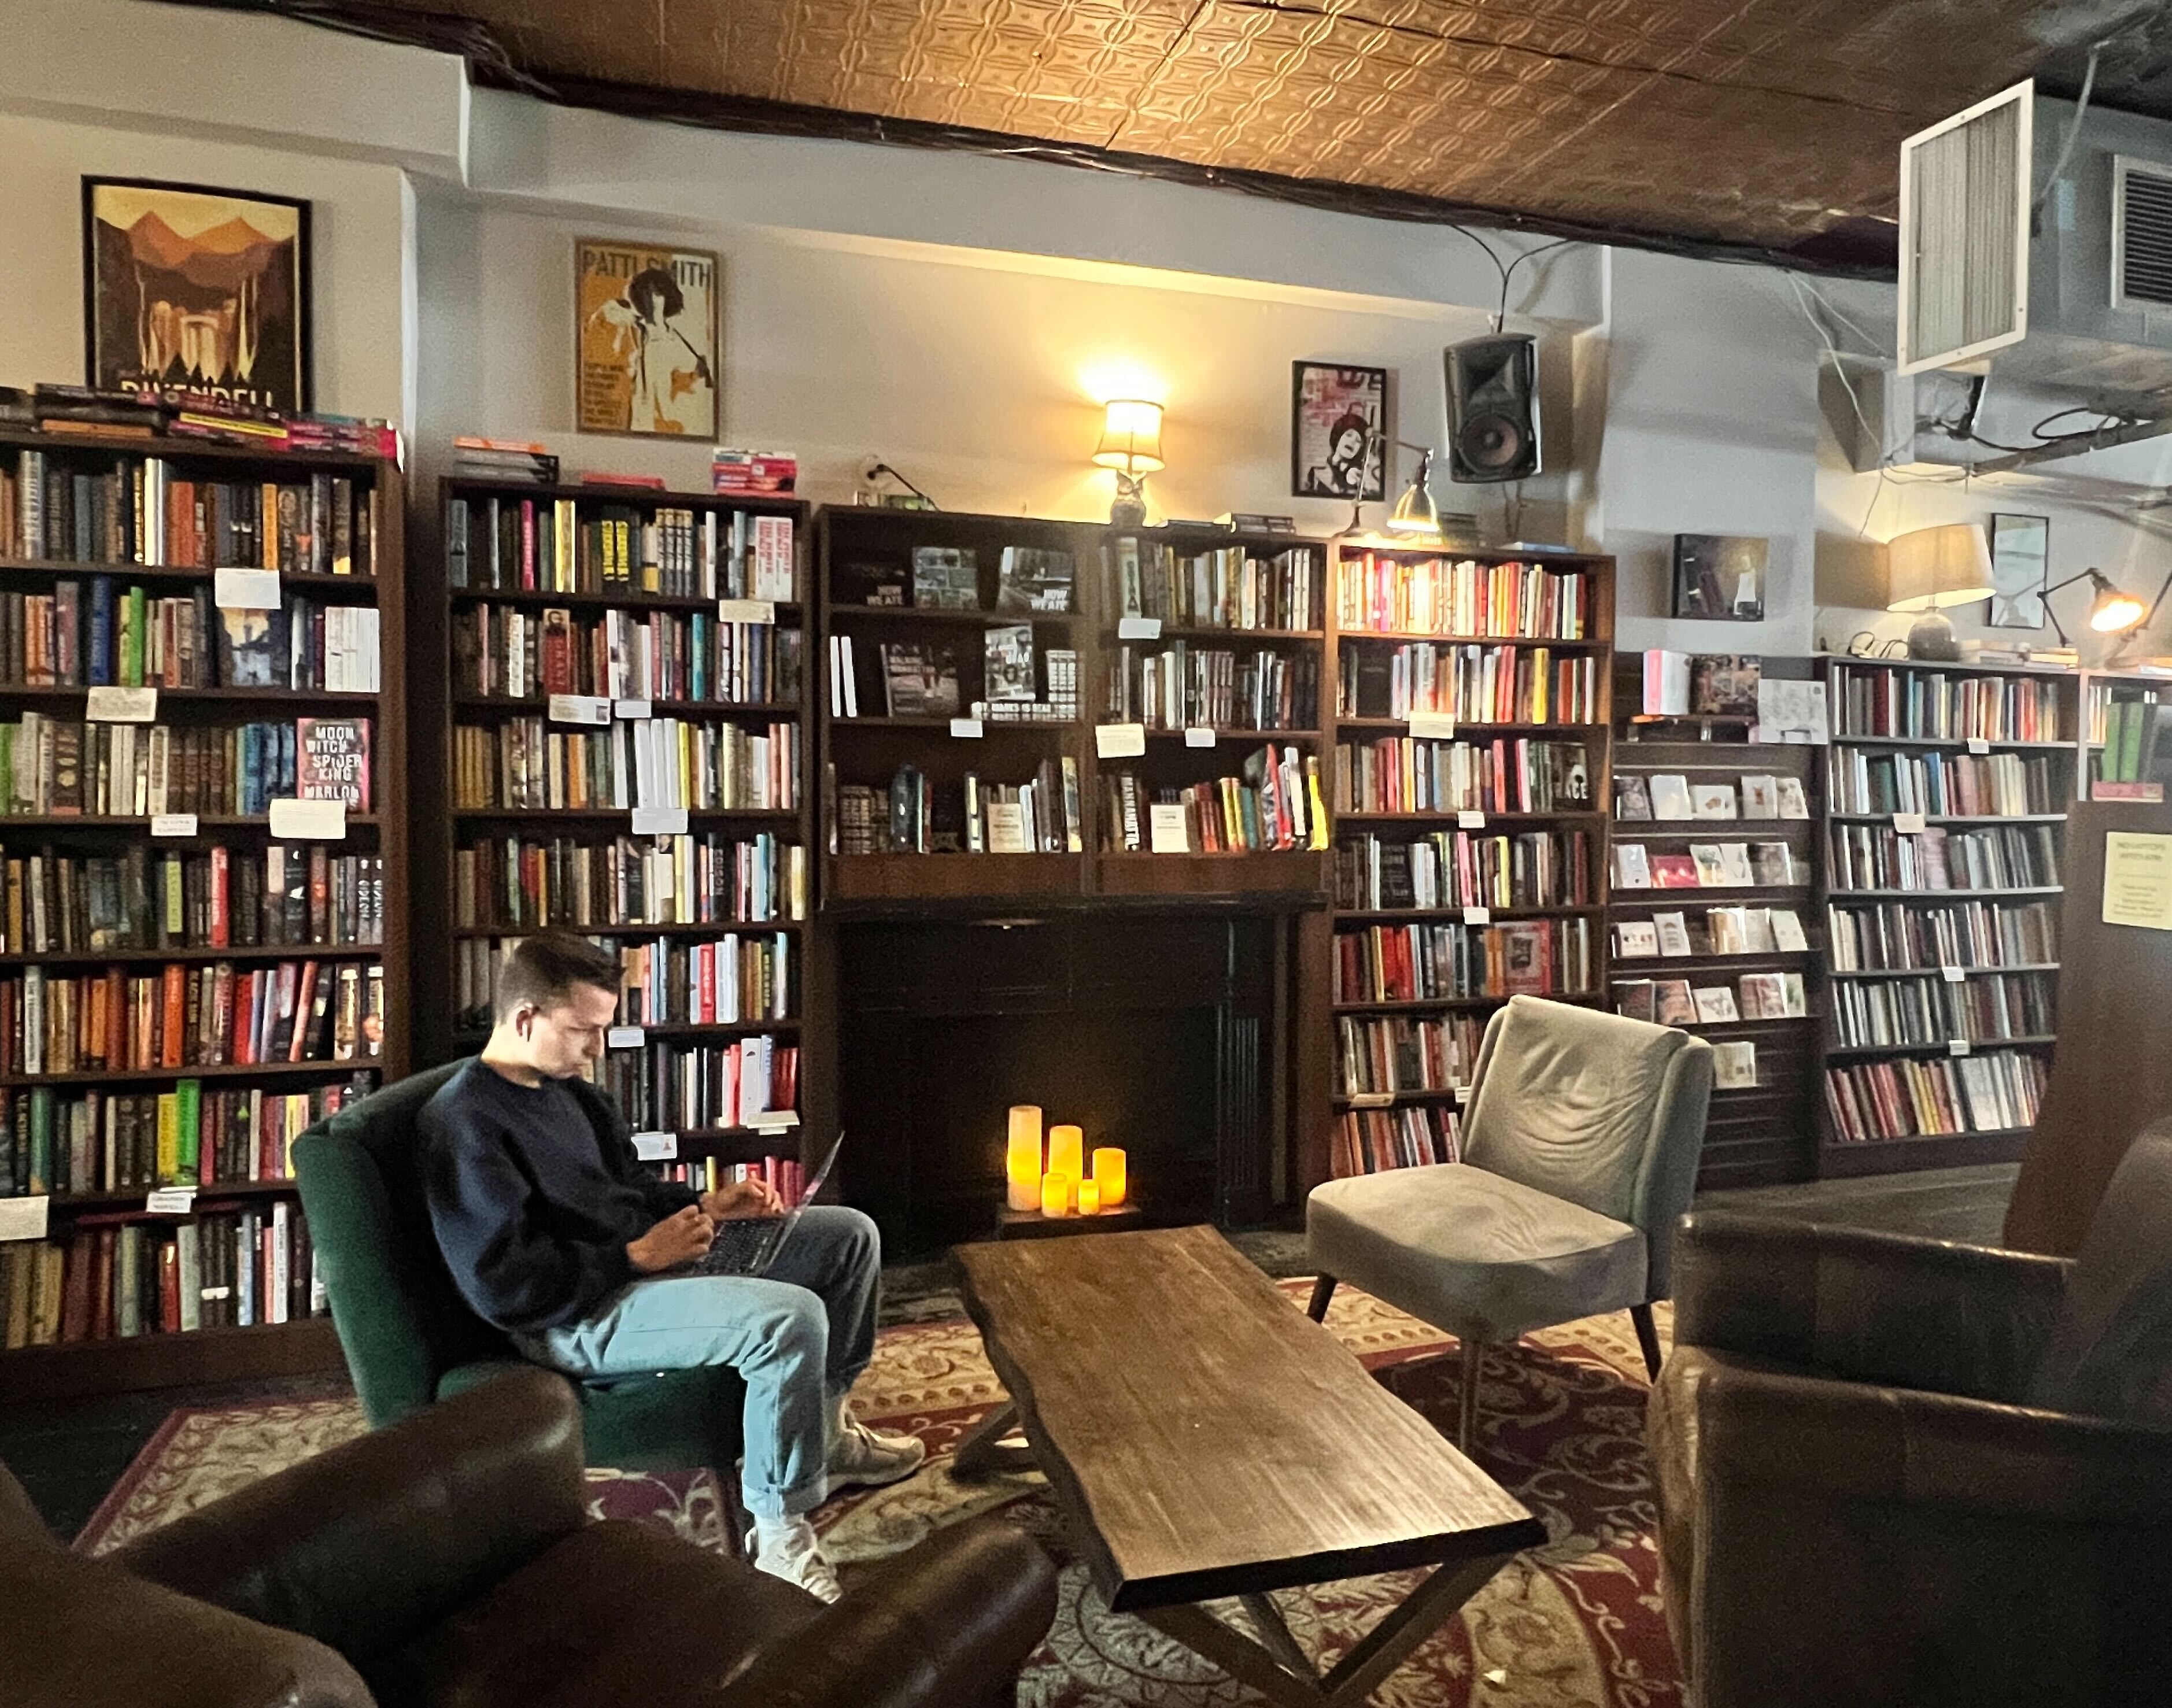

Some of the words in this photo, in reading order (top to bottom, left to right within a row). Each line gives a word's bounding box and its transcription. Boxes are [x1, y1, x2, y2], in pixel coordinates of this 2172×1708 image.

[583, 251, 637, 278] PATTI
[316, 726, 353, 740] MOON
[306, 740, 346, 753] WITCH
[312, 755, 362, 768] SPIDER
[319, 767, 352, 781] KING
[714, 848, 724, 895] EDISON
